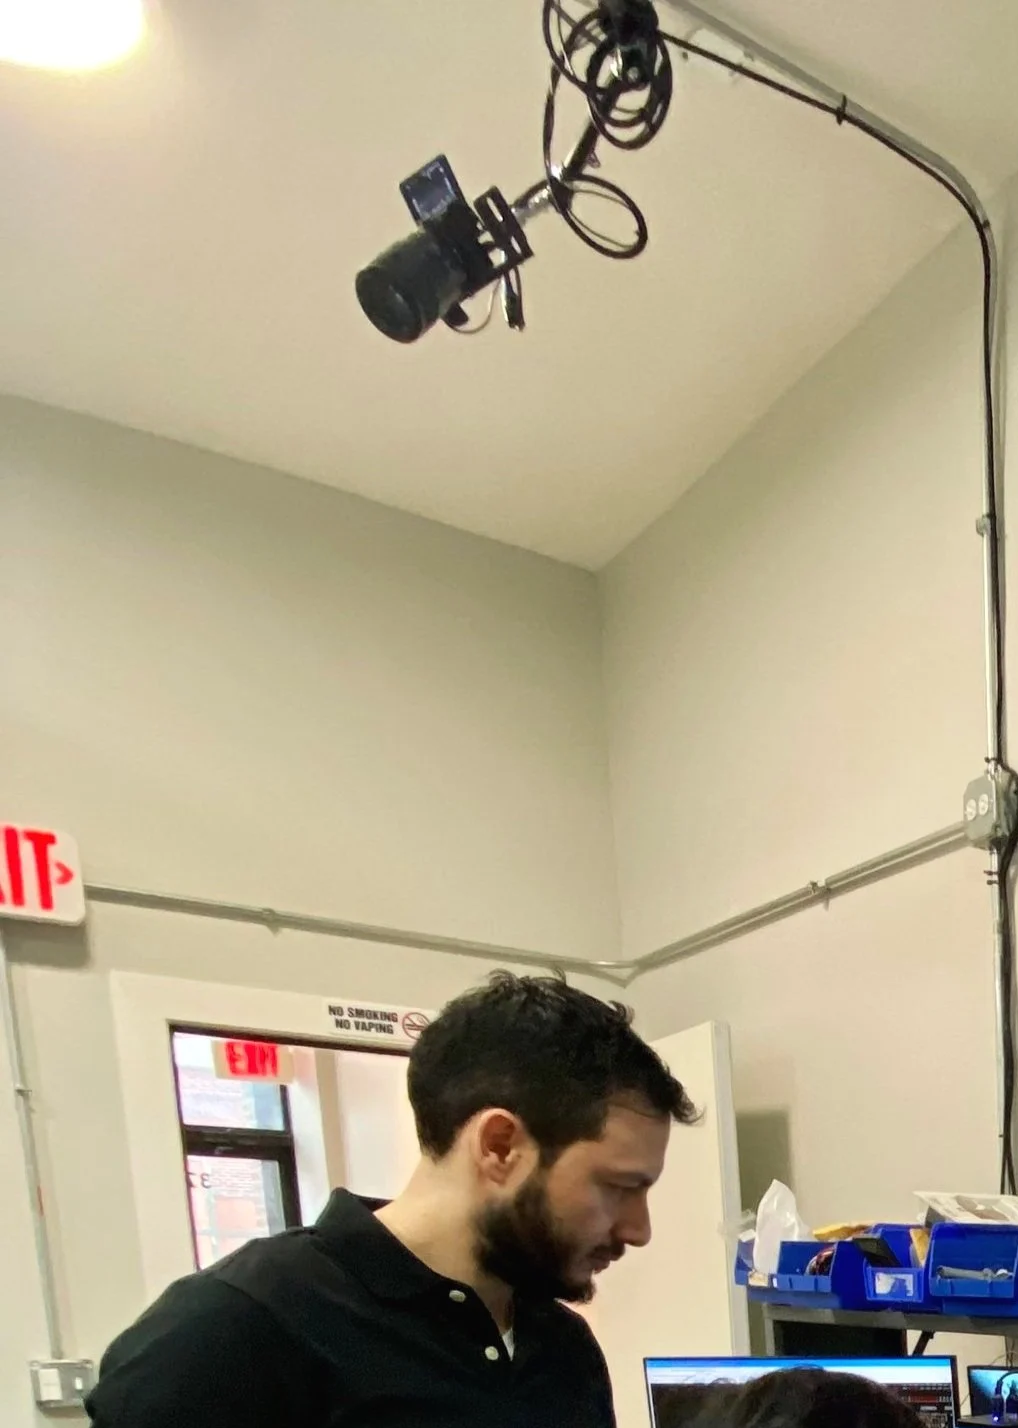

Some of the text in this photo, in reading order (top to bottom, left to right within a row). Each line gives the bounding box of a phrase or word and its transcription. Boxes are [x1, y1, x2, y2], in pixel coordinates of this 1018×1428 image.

[0, 826, 56, 911] IT
[327, 1005, 399, 1023] NO SMOKING
[335, 1018, 394, 1034] NO VAPING
[225, 1042, 278, 1077] EXIT
